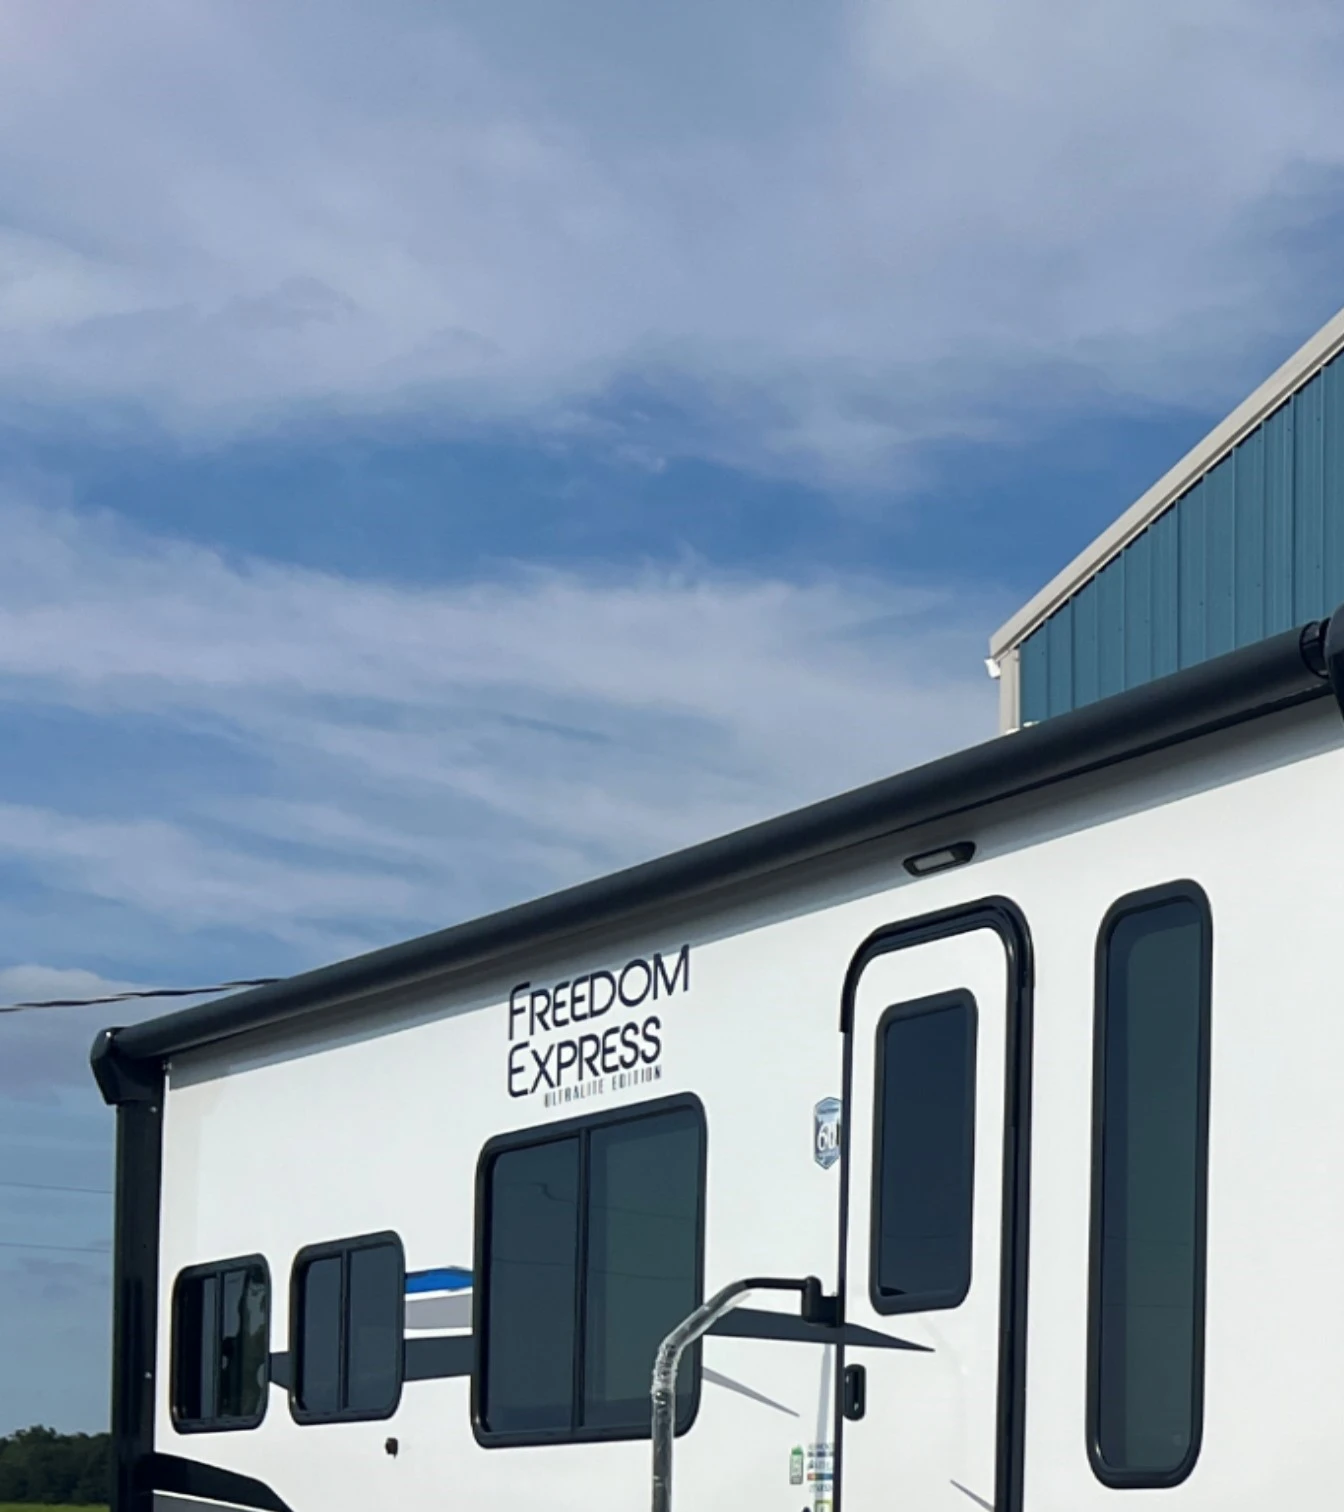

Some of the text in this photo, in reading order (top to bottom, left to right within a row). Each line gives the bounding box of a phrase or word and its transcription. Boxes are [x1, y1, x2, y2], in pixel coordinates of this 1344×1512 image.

[508, 943, 690, 1041] FREEDOM
[507, 1015, 662, 1098] EXPRESS
[543, 1064, 663, 1108] ULTRALITE EDITION
